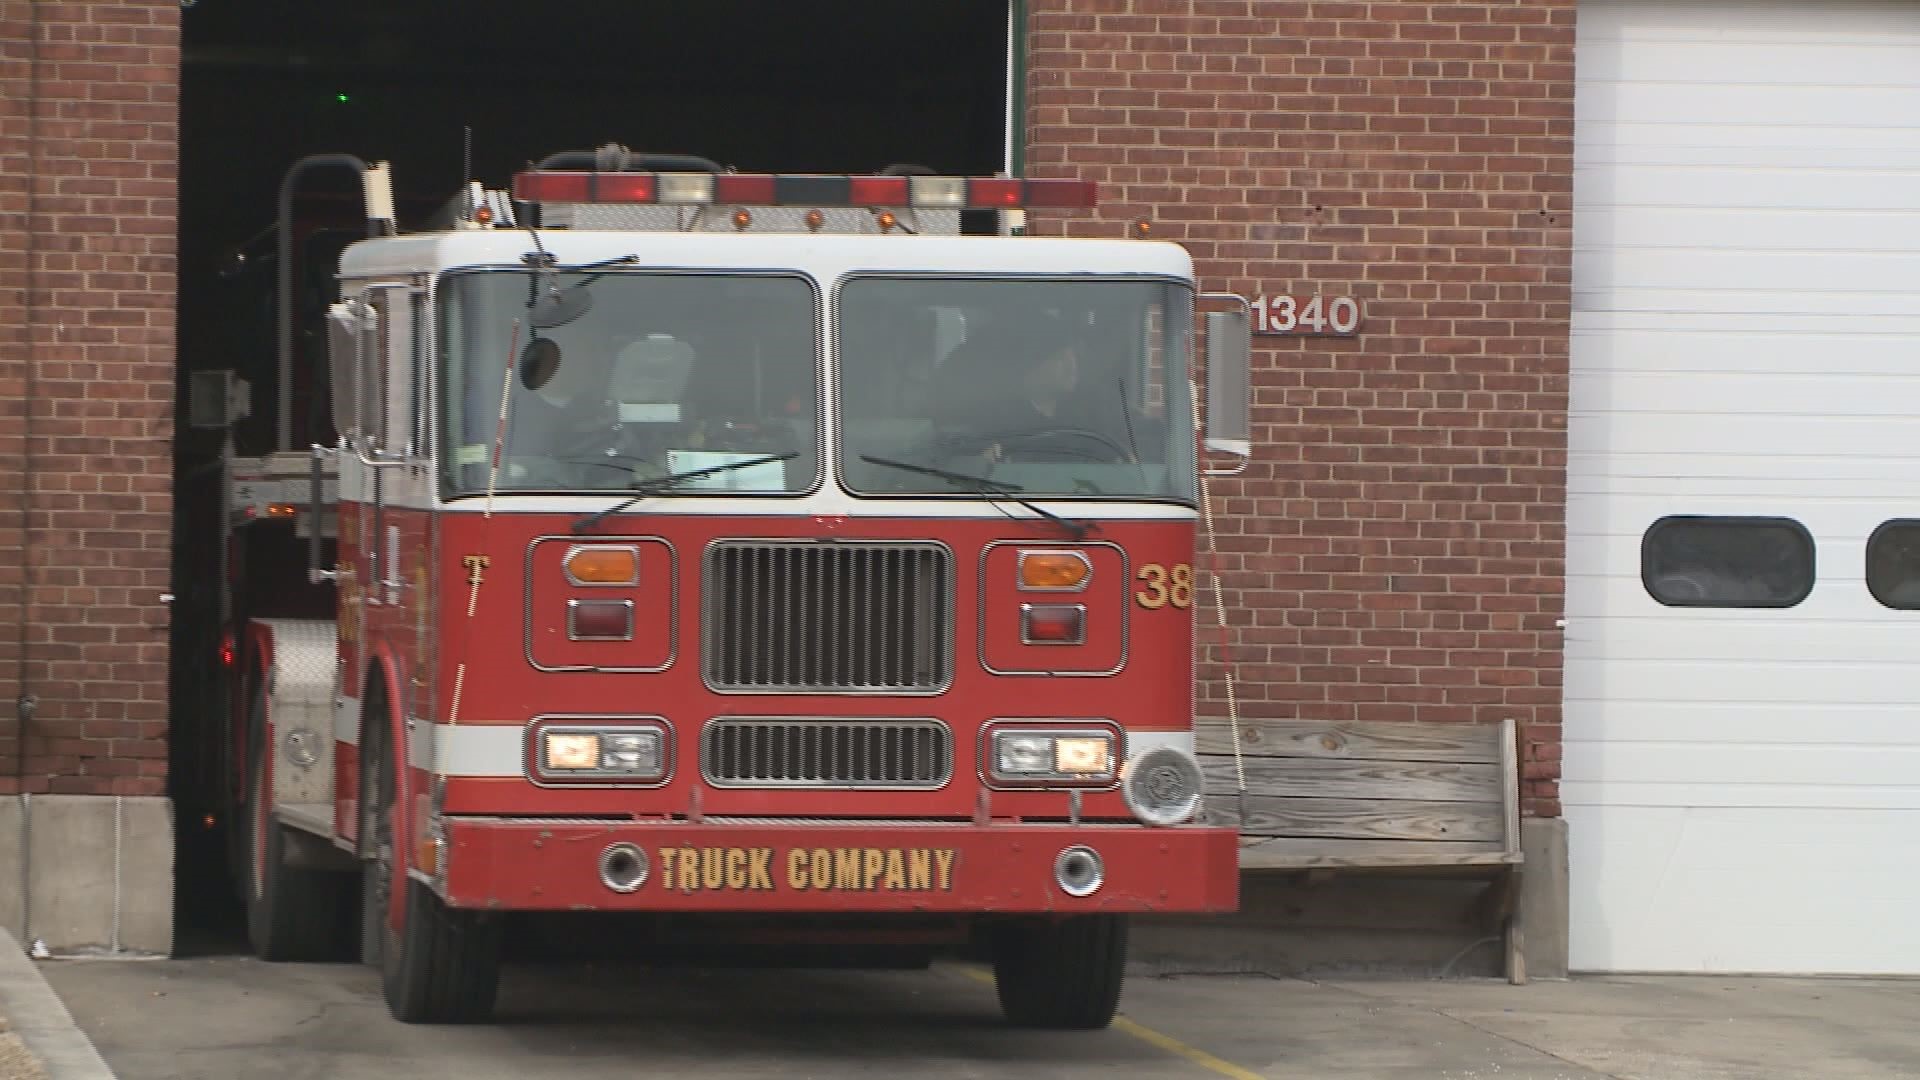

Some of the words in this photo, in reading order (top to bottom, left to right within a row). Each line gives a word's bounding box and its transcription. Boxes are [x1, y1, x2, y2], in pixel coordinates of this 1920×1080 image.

[1251, 295, 1359, 333] 1340
[463, 555, 491, 584] T
[1136, 563, 1195, 609] 38
[659, 847, 774, 890] TRUCK
[786, 848, 956, 891] COMPANY
